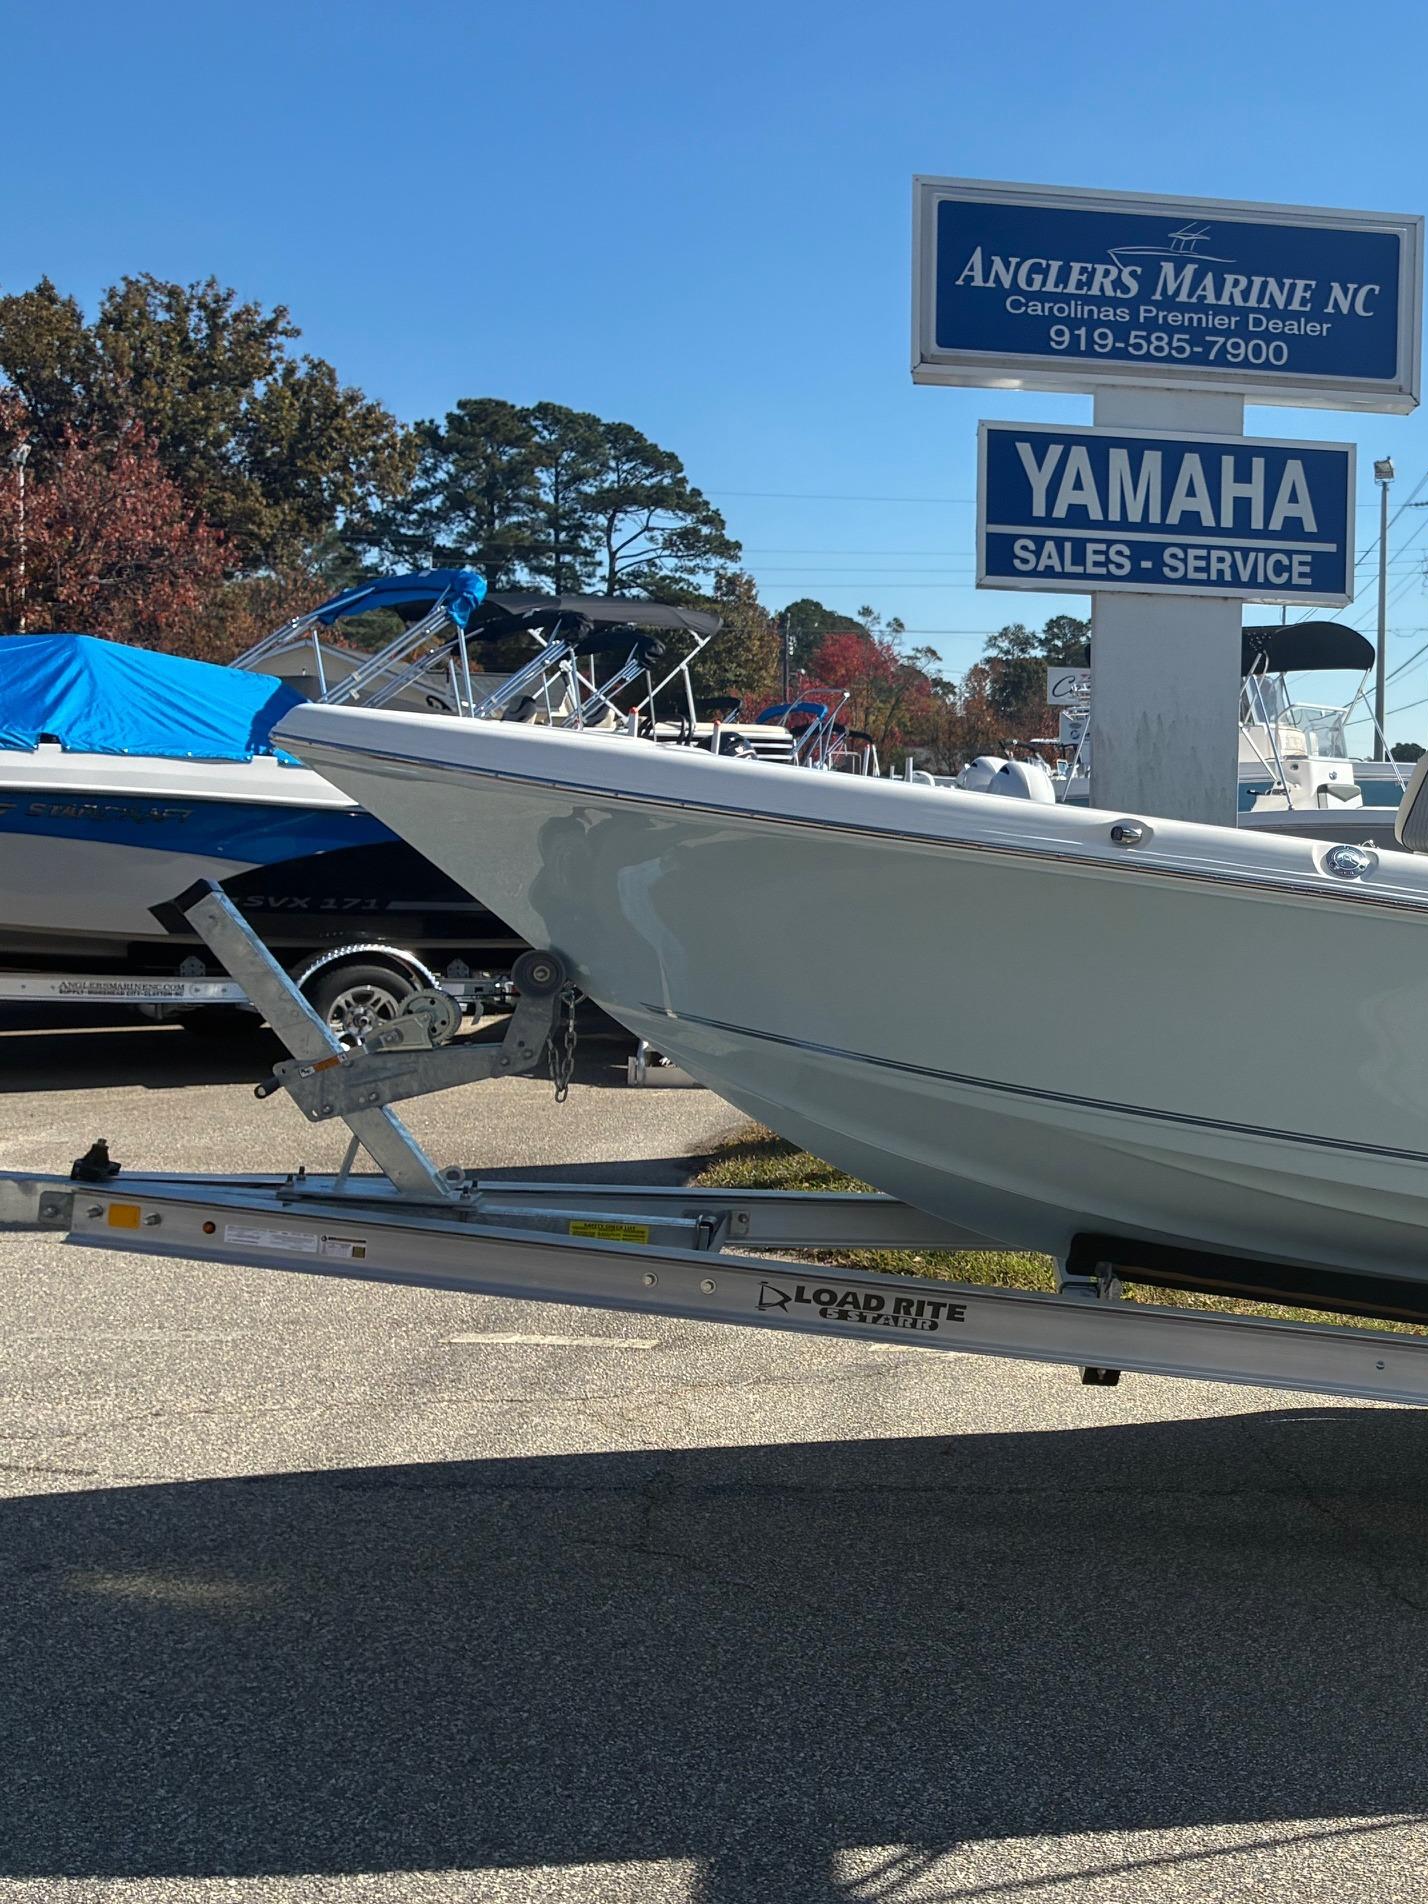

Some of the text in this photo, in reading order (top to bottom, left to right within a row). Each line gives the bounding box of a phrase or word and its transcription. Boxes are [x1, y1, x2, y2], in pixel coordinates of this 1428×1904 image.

[955, 246, 1381, 317] ANGLERS MARINE NC
[1005, 295, 1332, 337] Carolinas Premier Dealer
[1049, 324, 1289, 367] 919-585-7900
[1015, 441, 1318, 533] YAMAHA
[1012, 538, 1132, 576] SALES
[1162, 547, 1312, 585] SERVICE
[243, 896, 311, 908] SVX
[794, 1285, 968, 1322] LOAD RITE
[826, 1309, 933, 1331] 5 STARR
